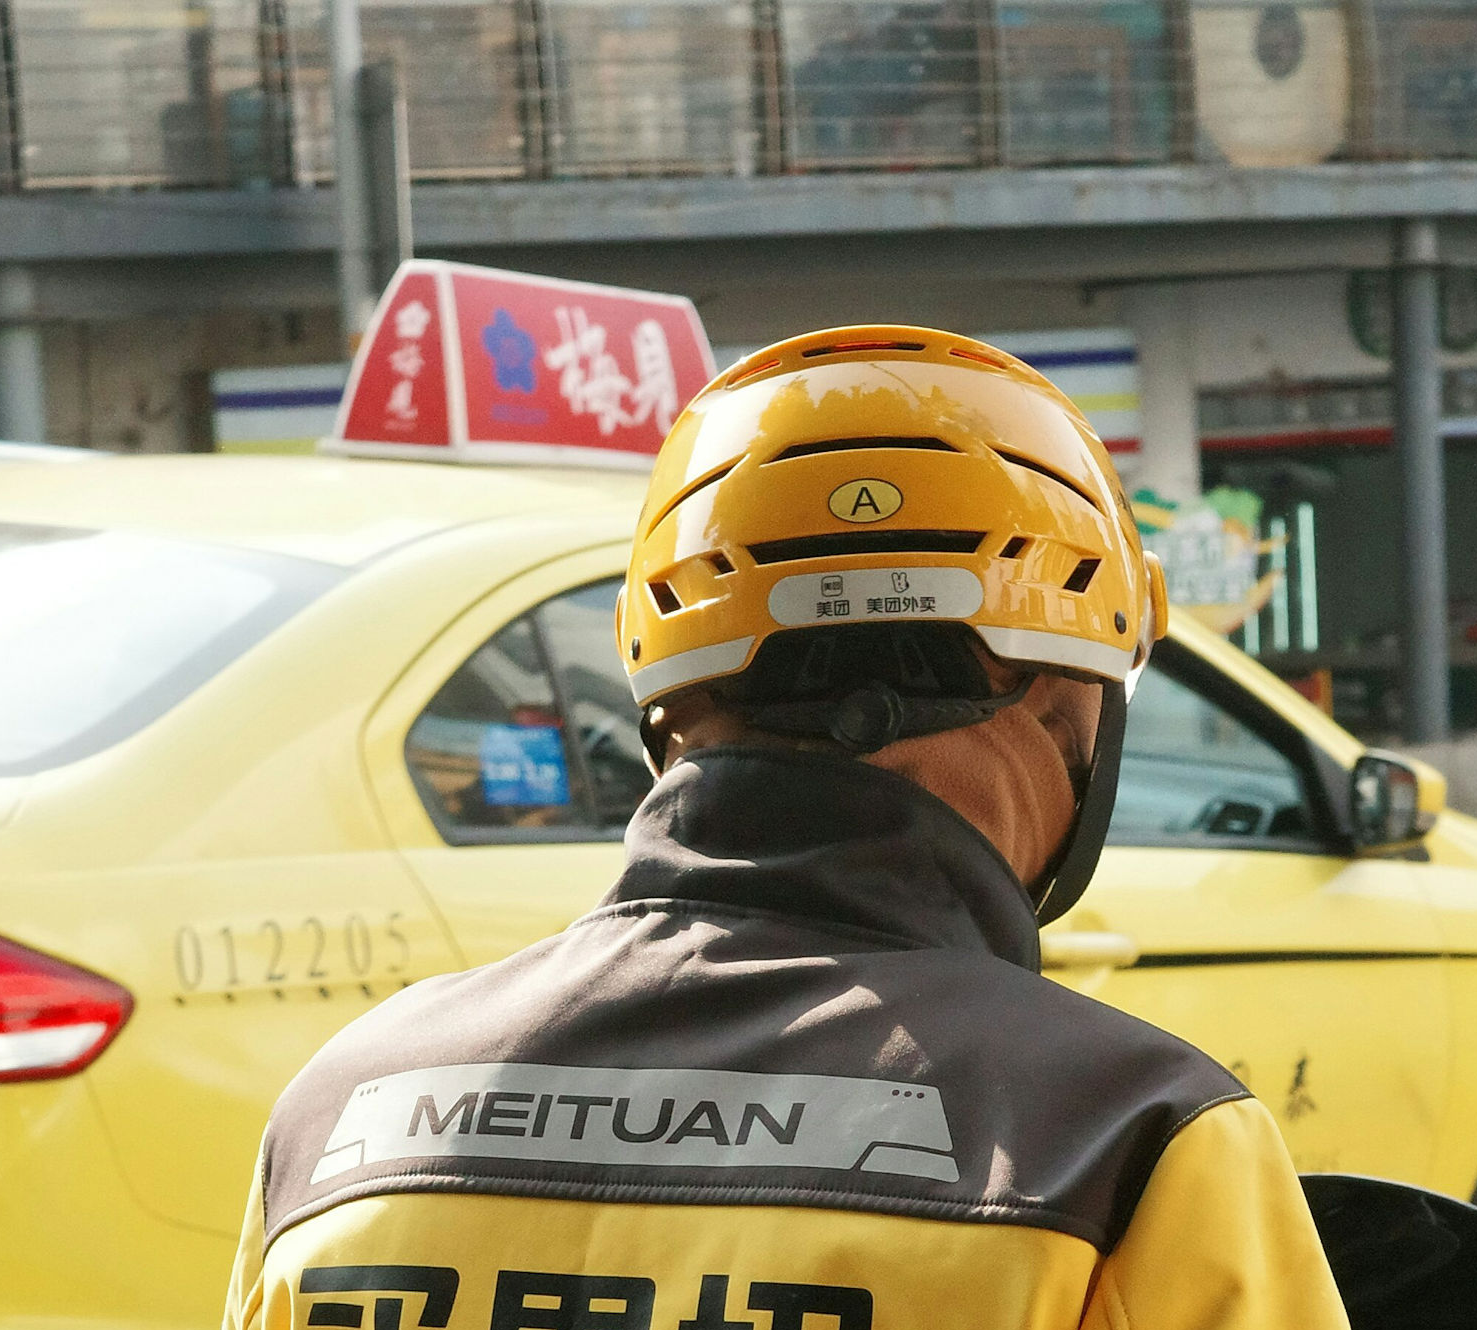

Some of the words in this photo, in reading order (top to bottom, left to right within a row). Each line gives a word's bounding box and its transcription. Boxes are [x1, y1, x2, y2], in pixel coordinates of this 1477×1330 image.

[850, 486, 882, 517] A
[816, 599, 851, 618] 美团
[866, 596, 937, 615] 美团外卖
[173, 911, 413, 992] 012205
[405, 1091, 807, 1148] MEITUAN
